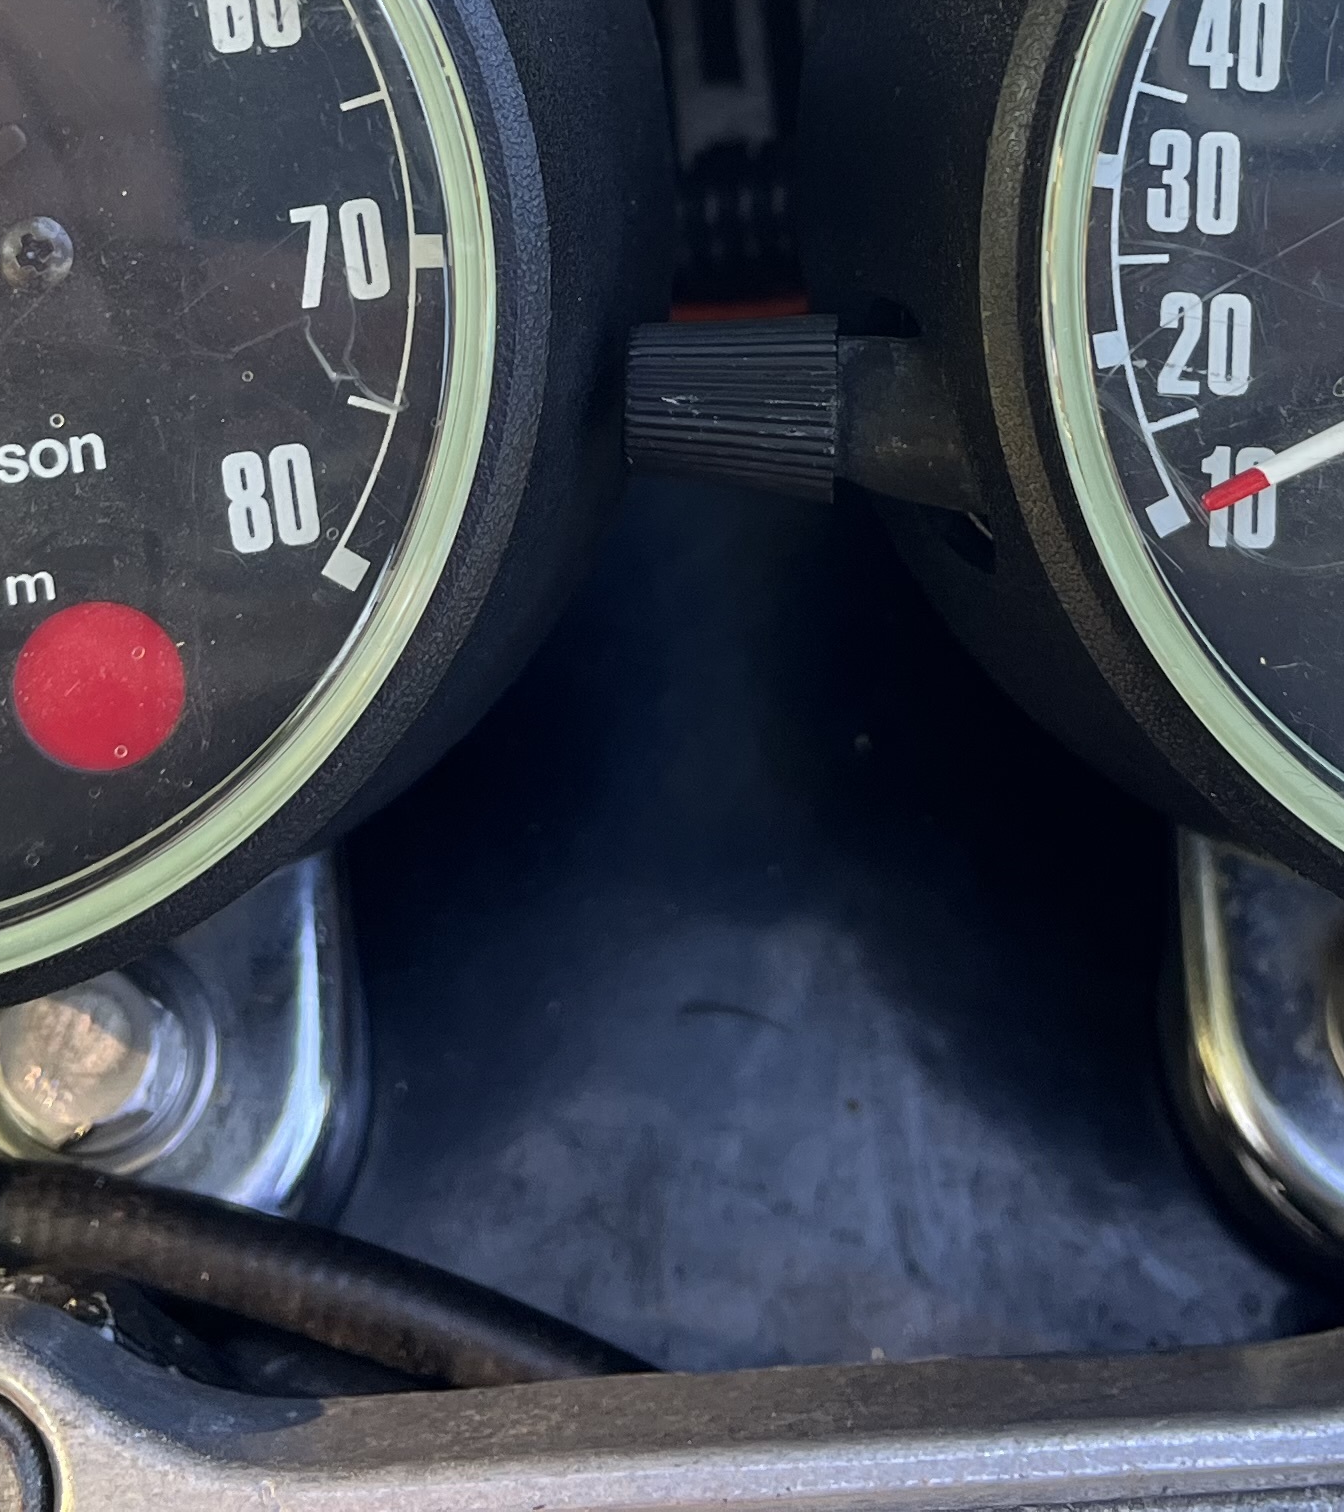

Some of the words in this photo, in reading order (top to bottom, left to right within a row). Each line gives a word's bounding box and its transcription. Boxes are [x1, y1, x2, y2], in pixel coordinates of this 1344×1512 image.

[1147, 128, 1241, 235] 30
[289, 197, 391, 309] 70
[1157, 292, 1252, 396] 20
[221, 443, 320, 553] 80
[1201, 445, 1277, 549] 10
